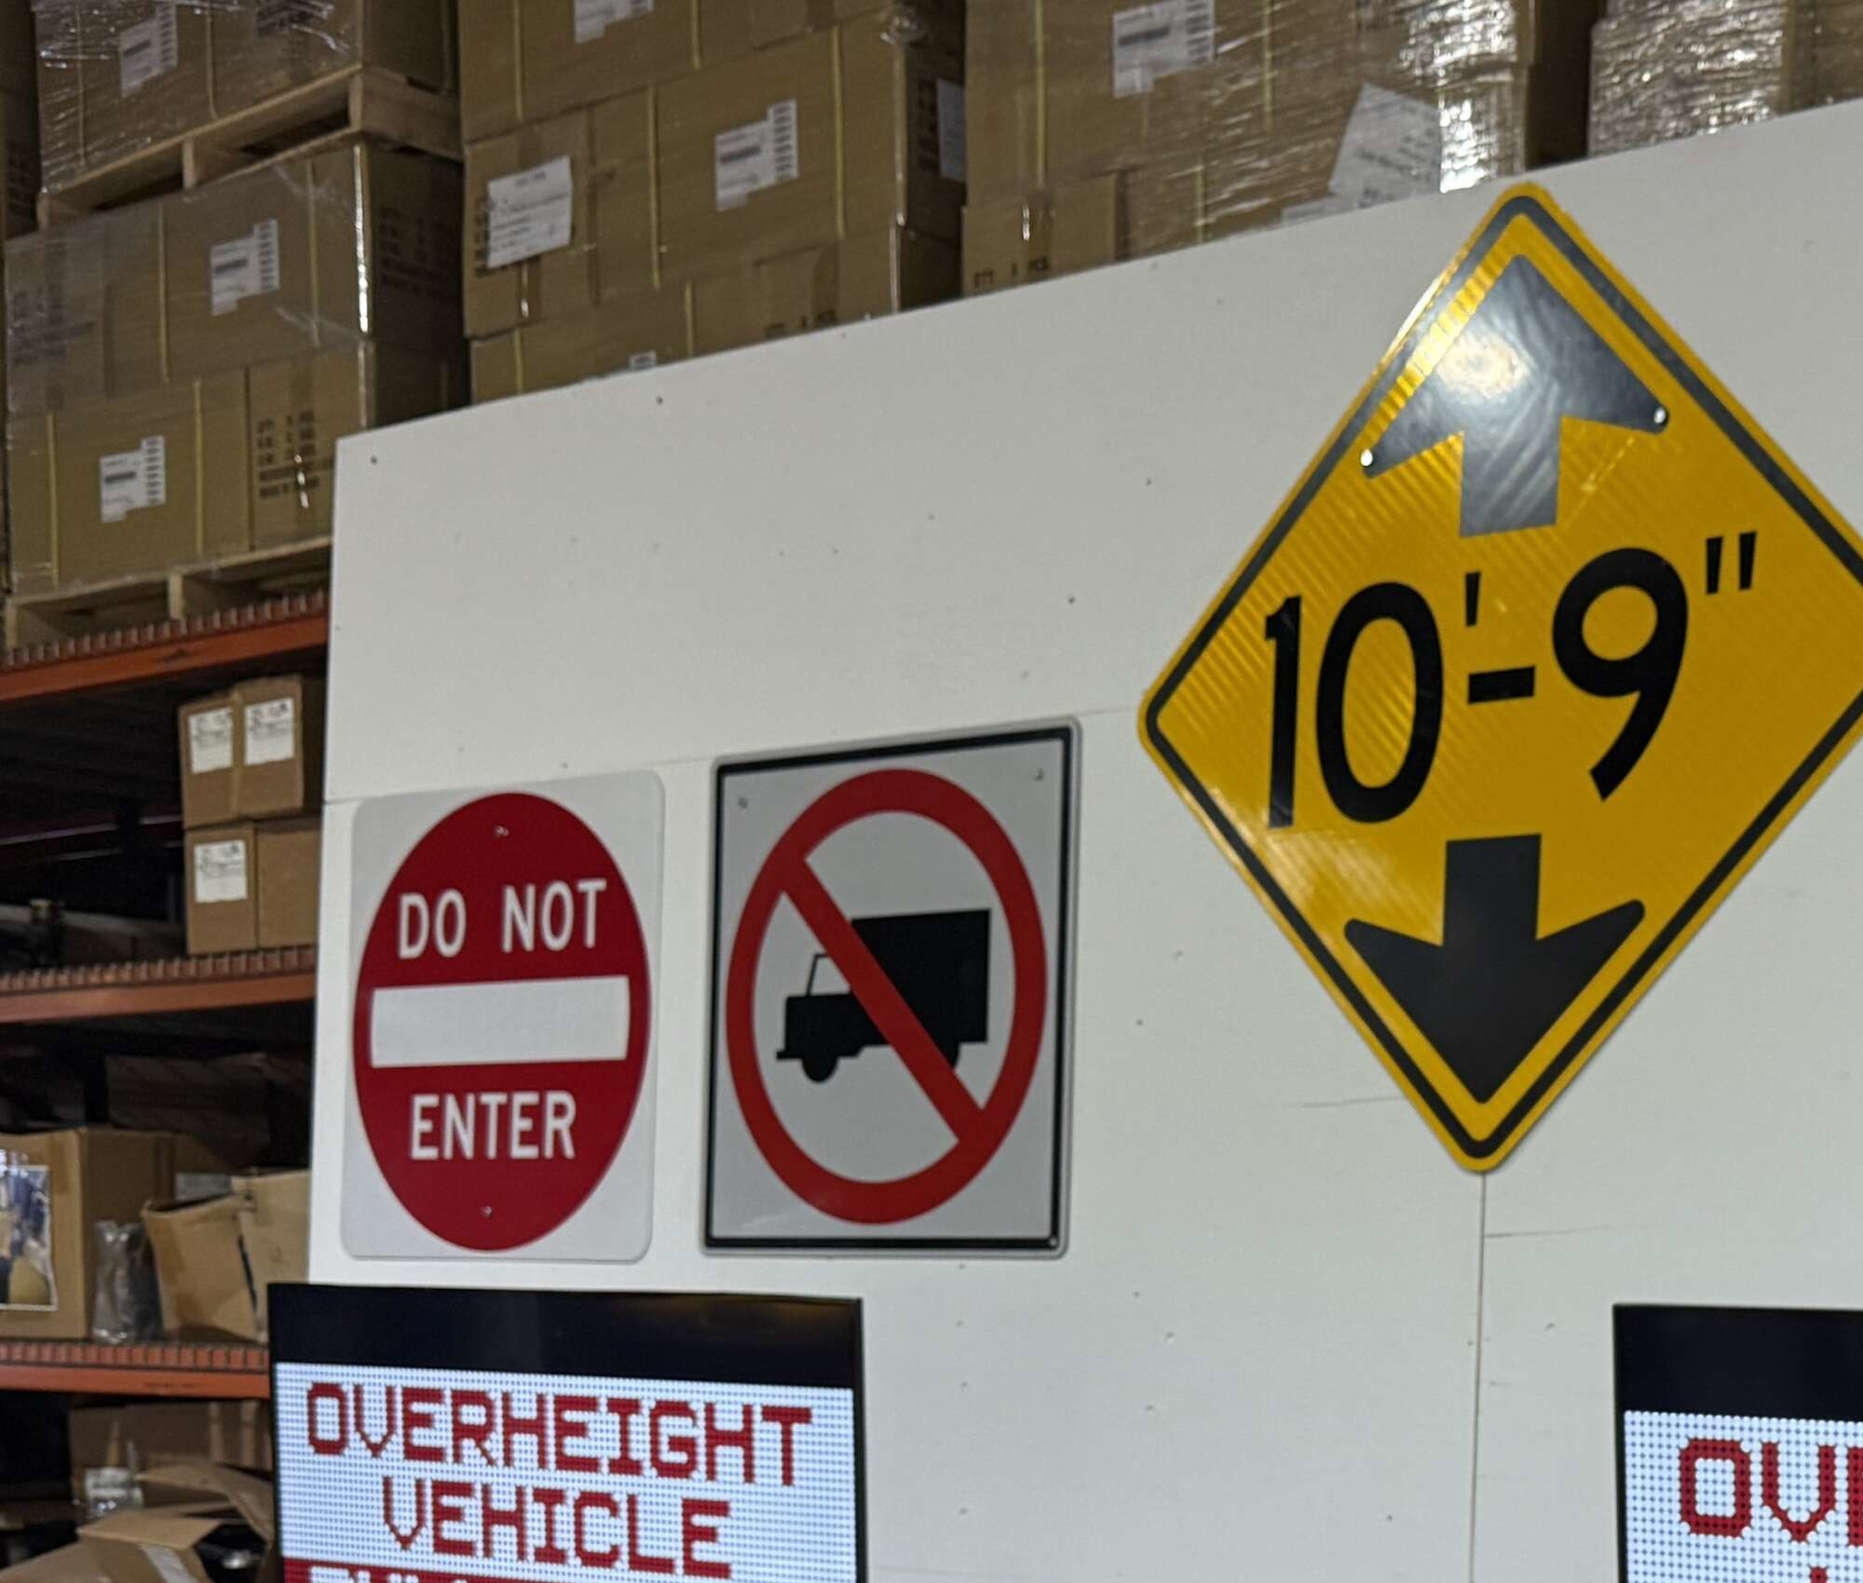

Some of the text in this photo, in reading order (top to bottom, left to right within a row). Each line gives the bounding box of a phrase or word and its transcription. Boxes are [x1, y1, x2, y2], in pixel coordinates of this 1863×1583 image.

[399, 879, 607, 959] DO NOT
[410, 1091, 577, 1161] ENTER
[307, 1381, 813, 1486] OVERHEIGHT
[383, 1476, 731, 1580] VEHICLE
